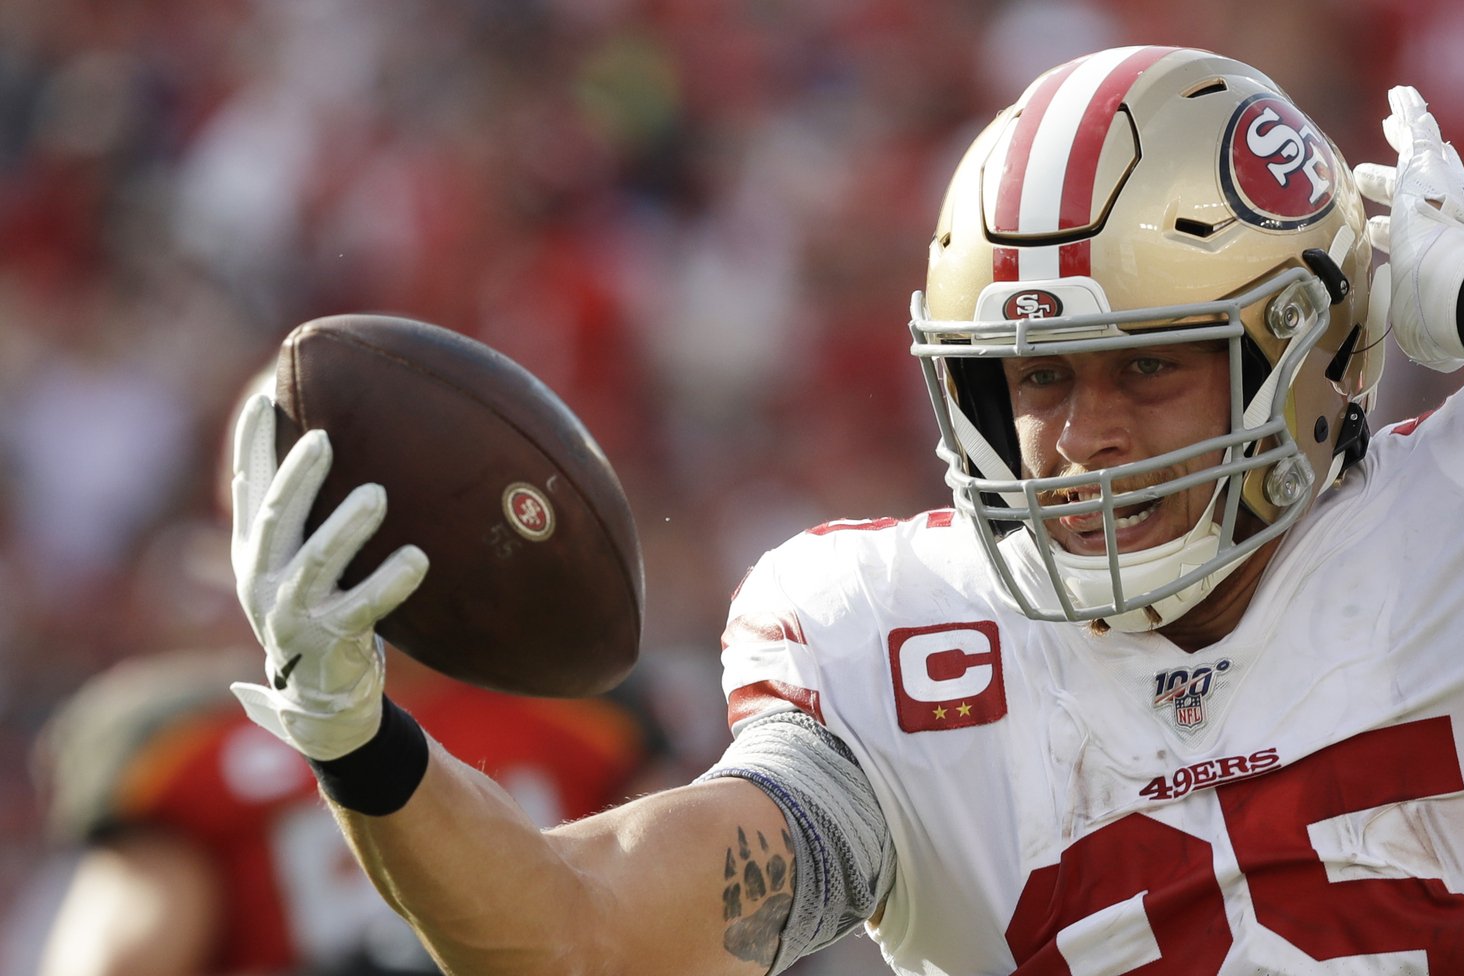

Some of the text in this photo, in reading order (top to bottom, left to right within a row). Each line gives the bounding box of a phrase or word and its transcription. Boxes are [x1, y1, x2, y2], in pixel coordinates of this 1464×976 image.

[1246, 106, 1330, 204] SF
[899, 628, 994, 703] C
[1178, 706, 1201, 725] NFL
[1138, 747, 1281, 801] 49ERS
